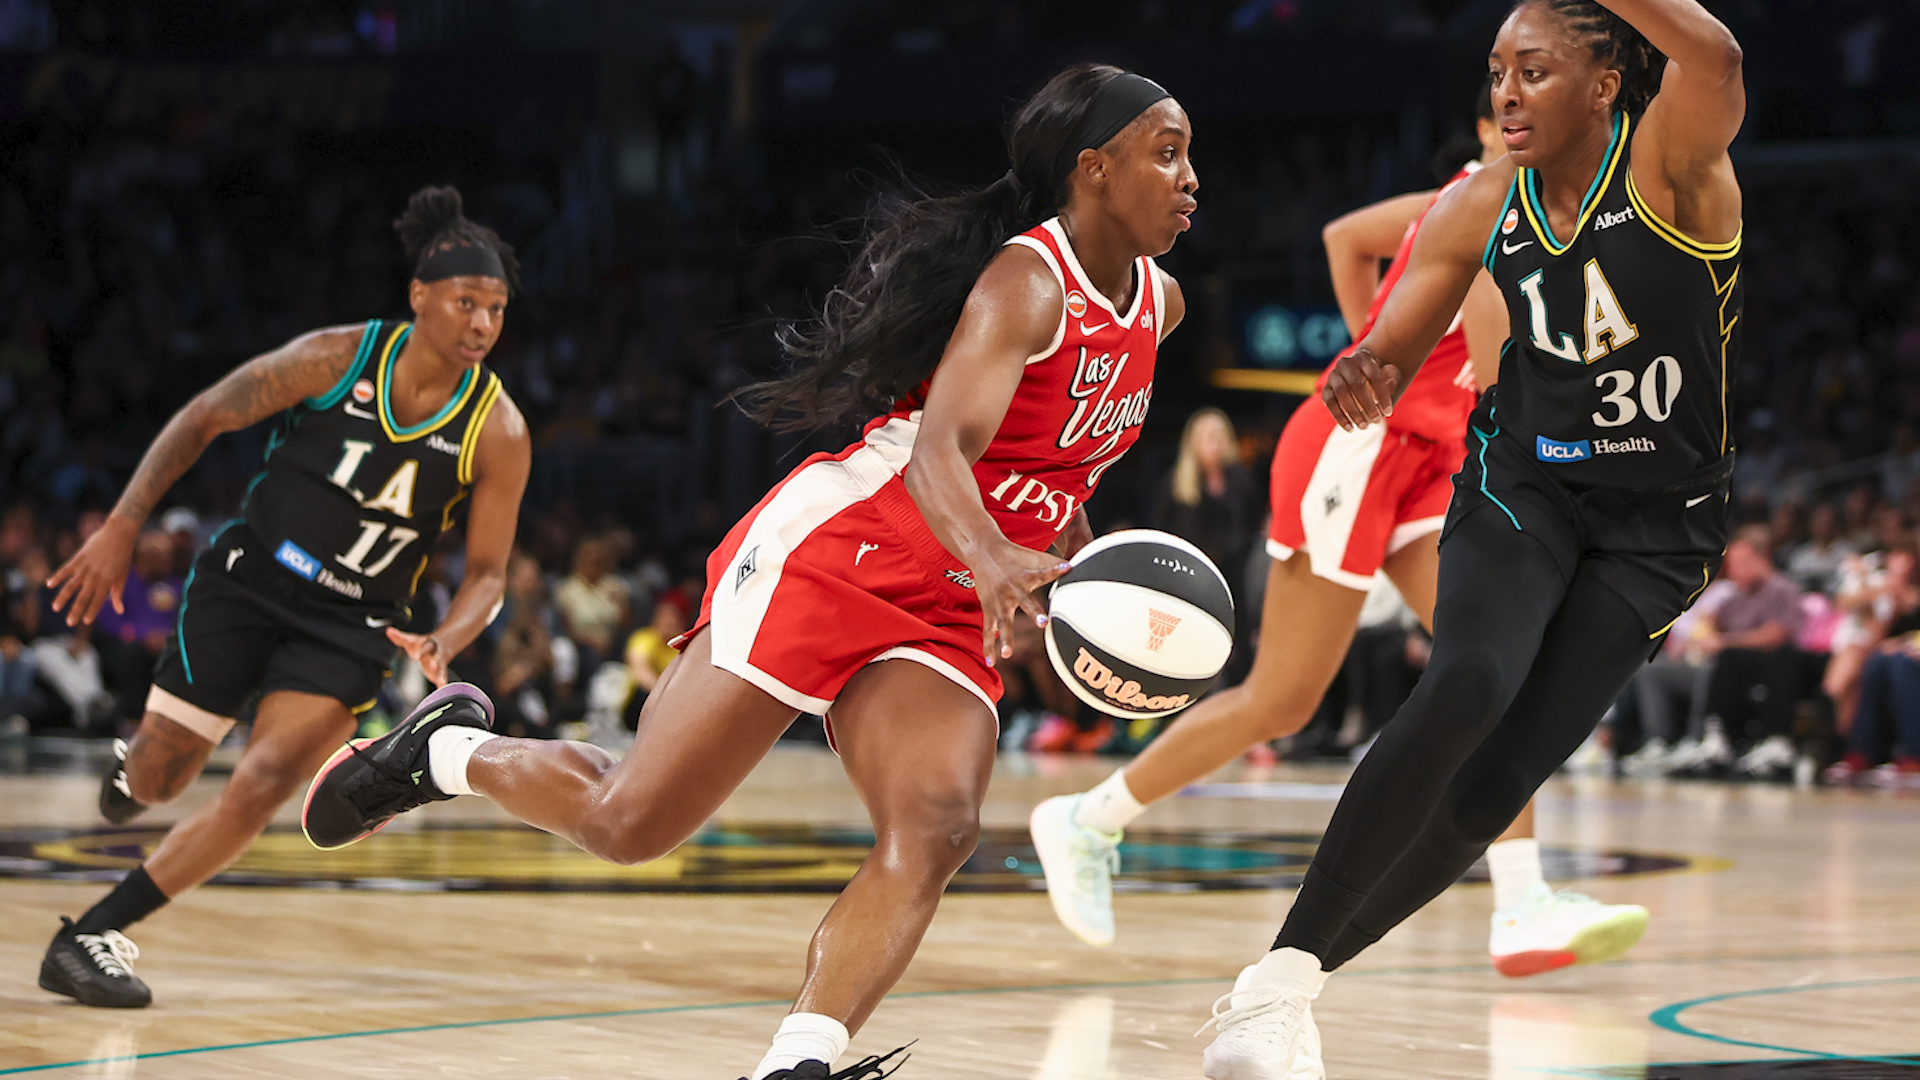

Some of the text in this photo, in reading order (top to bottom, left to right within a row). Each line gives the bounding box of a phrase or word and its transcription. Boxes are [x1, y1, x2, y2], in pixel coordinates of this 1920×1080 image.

[1594, 206, 1635, 231] Albert
[1518, 257, 1640, 365] LA
[1067, 345, 1115, 399] Las
[1591, 354, 1683, 428] 30
[1056, 351, 1154, 464] Vegas
[1541, 436, 1657, 459] UCLA Health
[327, 438, 419, 519] LA
[280, 546, 365, 600] UCLA Health
[334, 519, 420, 578] 17
[943, 569, 977, 589] Ace
[1073, 645, 1190, 711] Wilson
